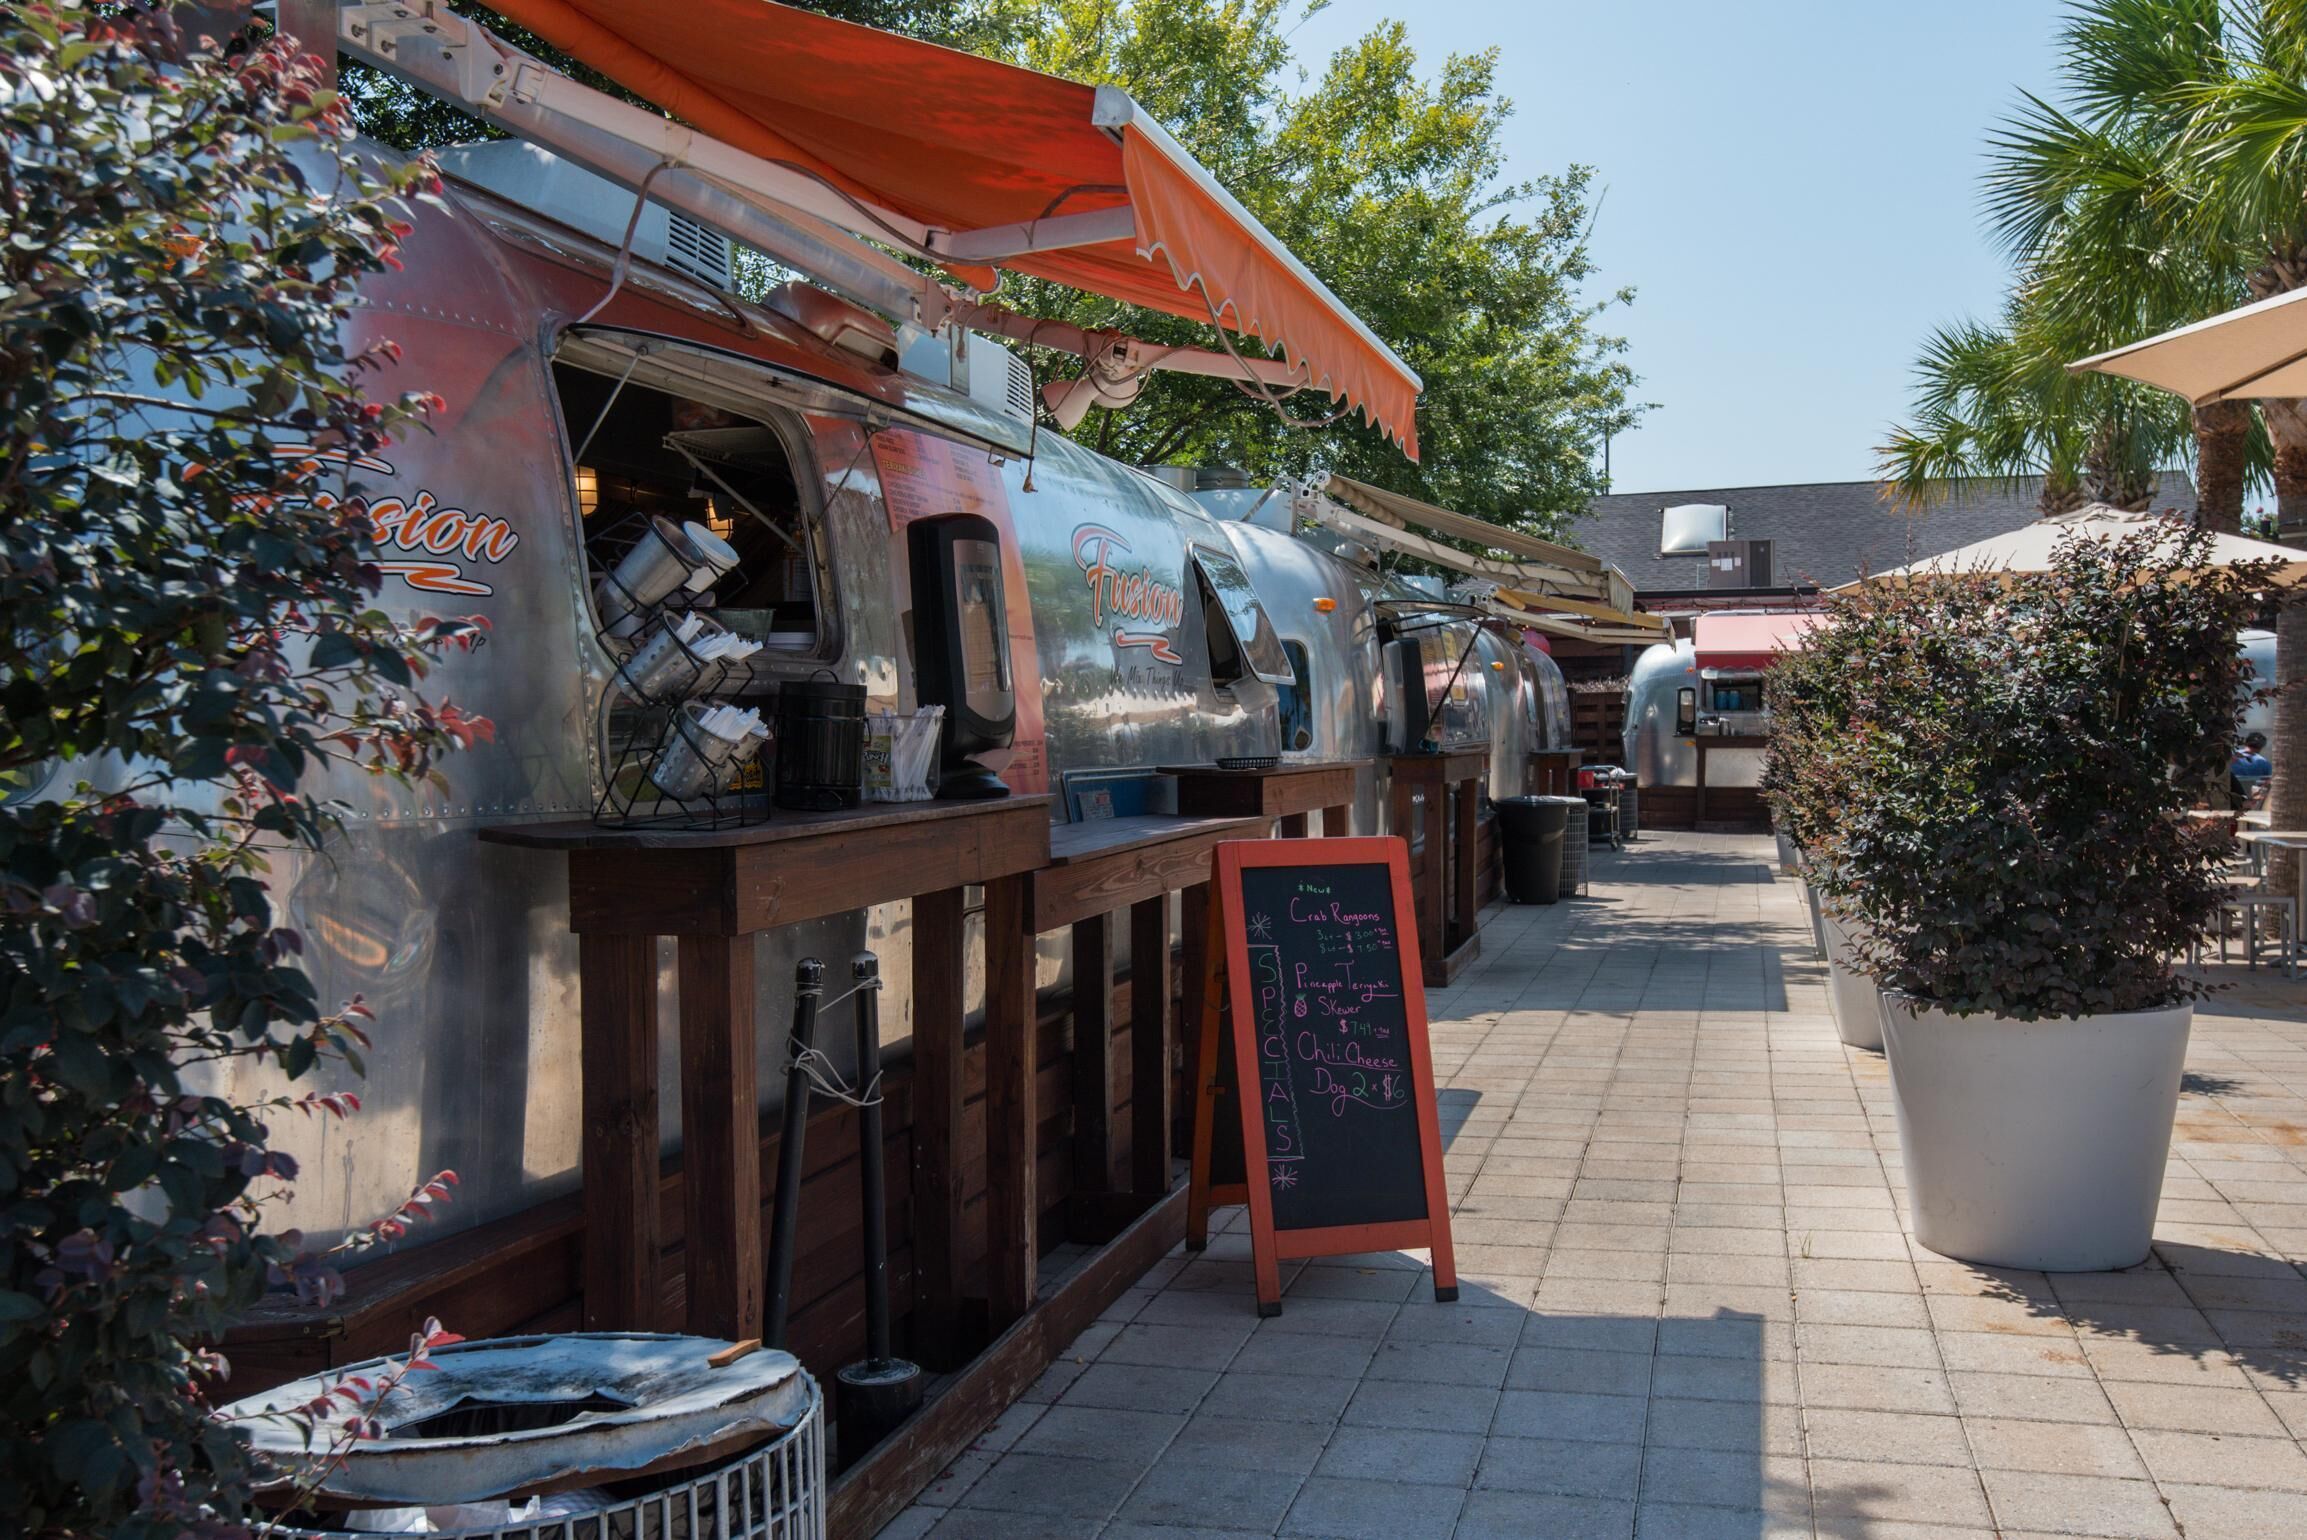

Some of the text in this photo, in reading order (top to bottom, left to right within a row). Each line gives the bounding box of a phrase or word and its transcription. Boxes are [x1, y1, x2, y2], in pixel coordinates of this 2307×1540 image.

[1071, 522, 1184, 629] Fusion
[1127, 665, 1142, 685] Mix
[1146, 666, 1171, 690] Things
[1290, 897, 1381, 926] Crab Rangoons
[1295, 960, 1398, 1002] Pineapple Teriyaki
[1258, 952, 1292, 1151] SPECIALS
[1297, 1032, 1398, 1068] Chili Cheese
[1309, 1067, 1347, 1117] Dog
